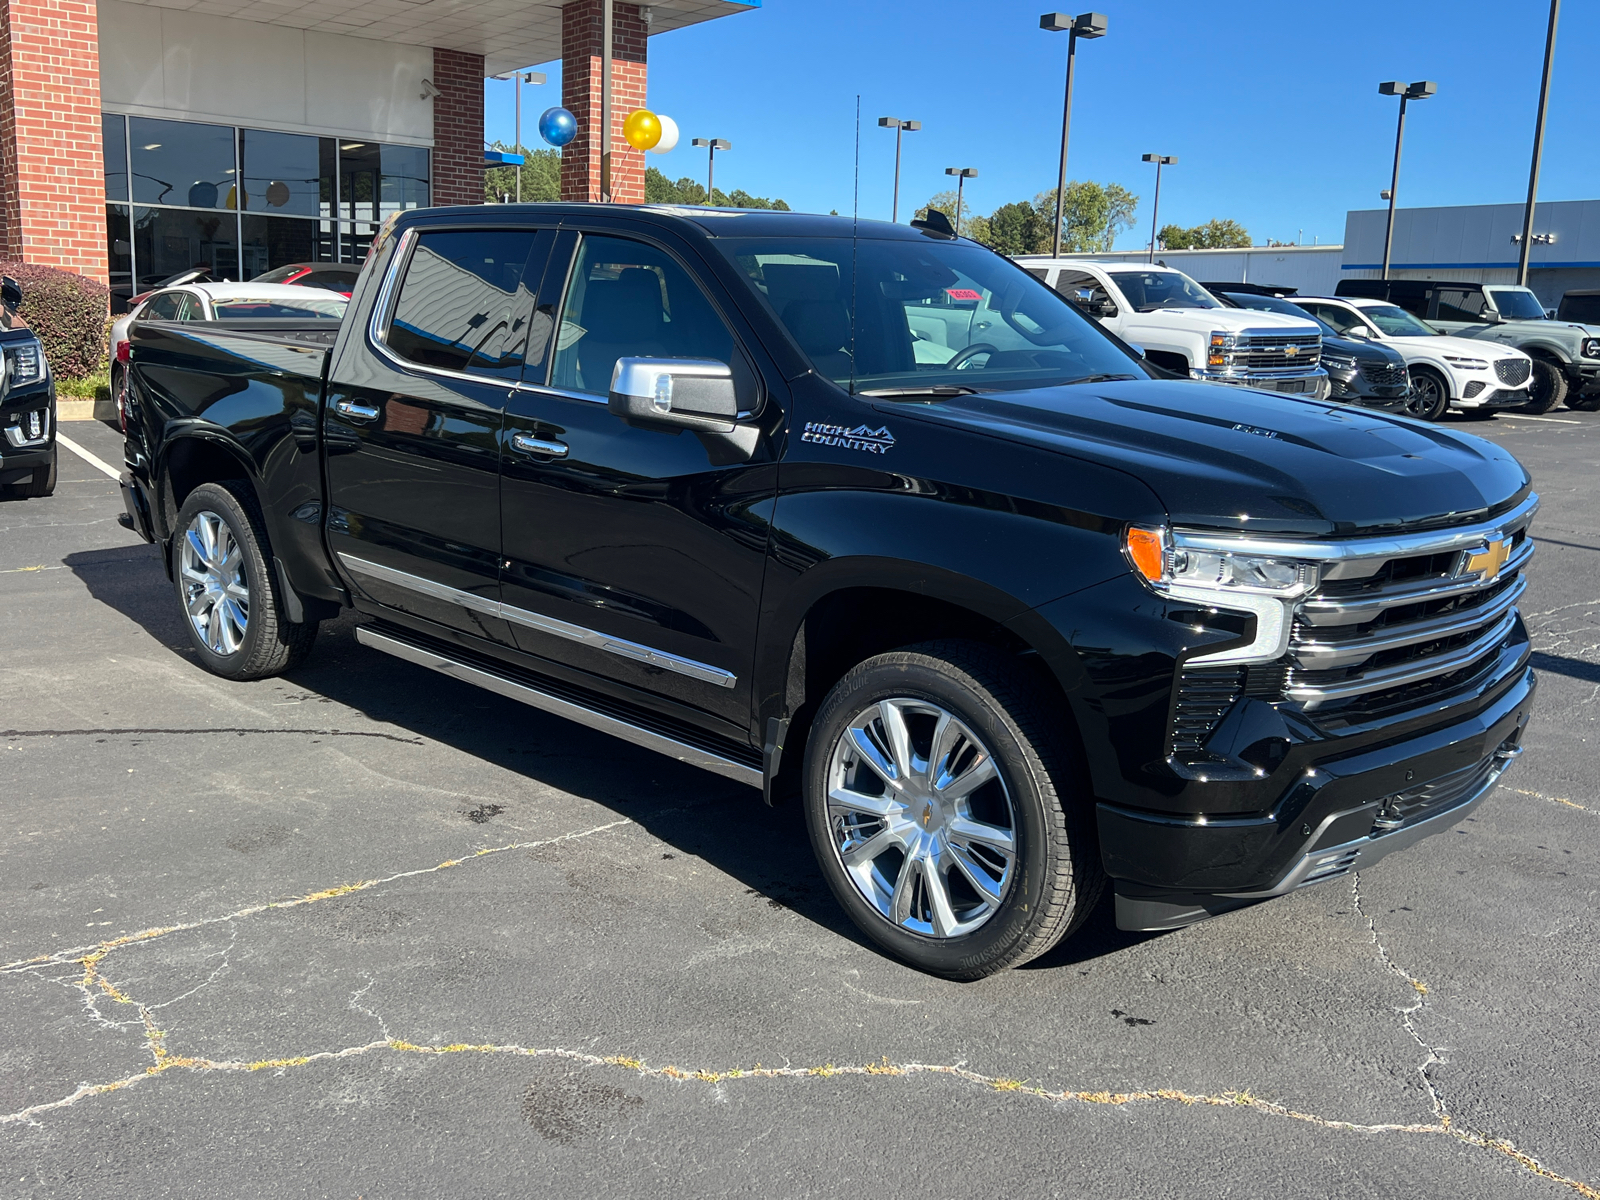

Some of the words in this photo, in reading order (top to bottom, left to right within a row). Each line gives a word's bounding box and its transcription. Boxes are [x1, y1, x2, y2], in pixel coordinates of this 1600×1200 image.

[804, 421, 851, 438] HIGH
[800, 431, 894, 454] COUNTRY
[959, 919, 1022, 969] BRIDGESTONE
